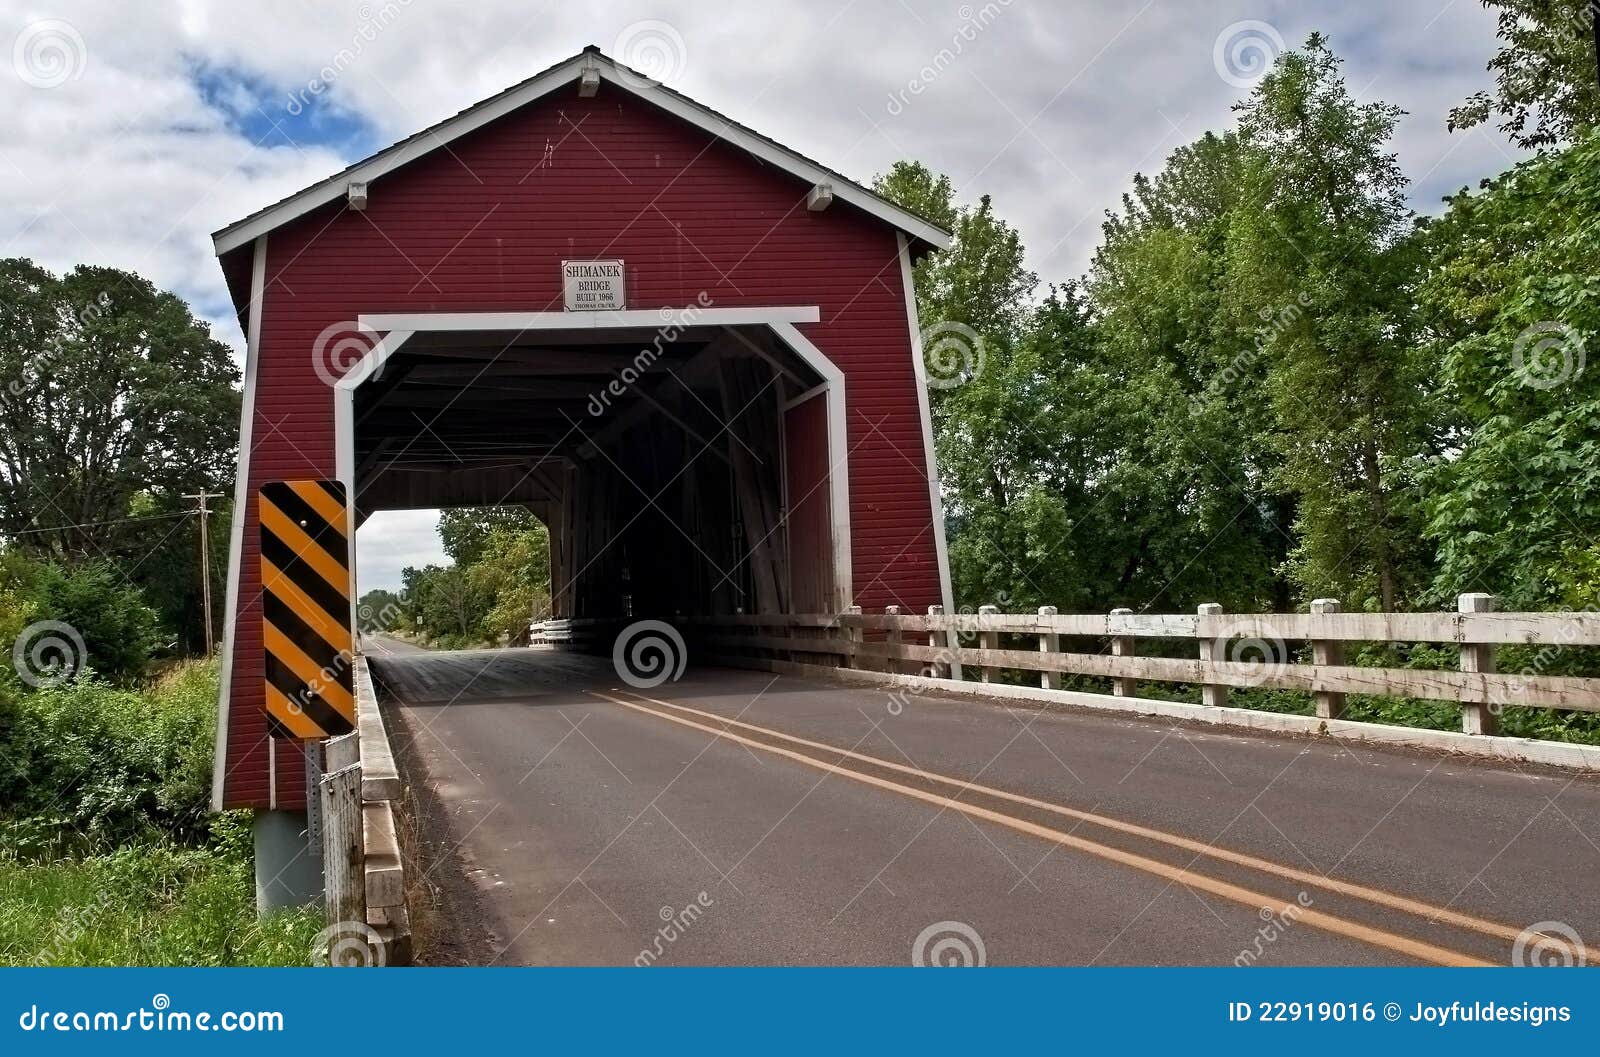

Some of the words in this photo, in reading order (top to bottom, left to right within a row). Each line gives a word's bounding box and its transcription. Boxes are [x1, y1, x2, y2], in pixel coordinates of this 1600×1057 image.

[566, 265, 620, 277] SHIMANEK
[578, 281, 610, 291] BRIDGE
[576, 293, 597, 302] BUILT
[599, 293, 614, 301] 1966
